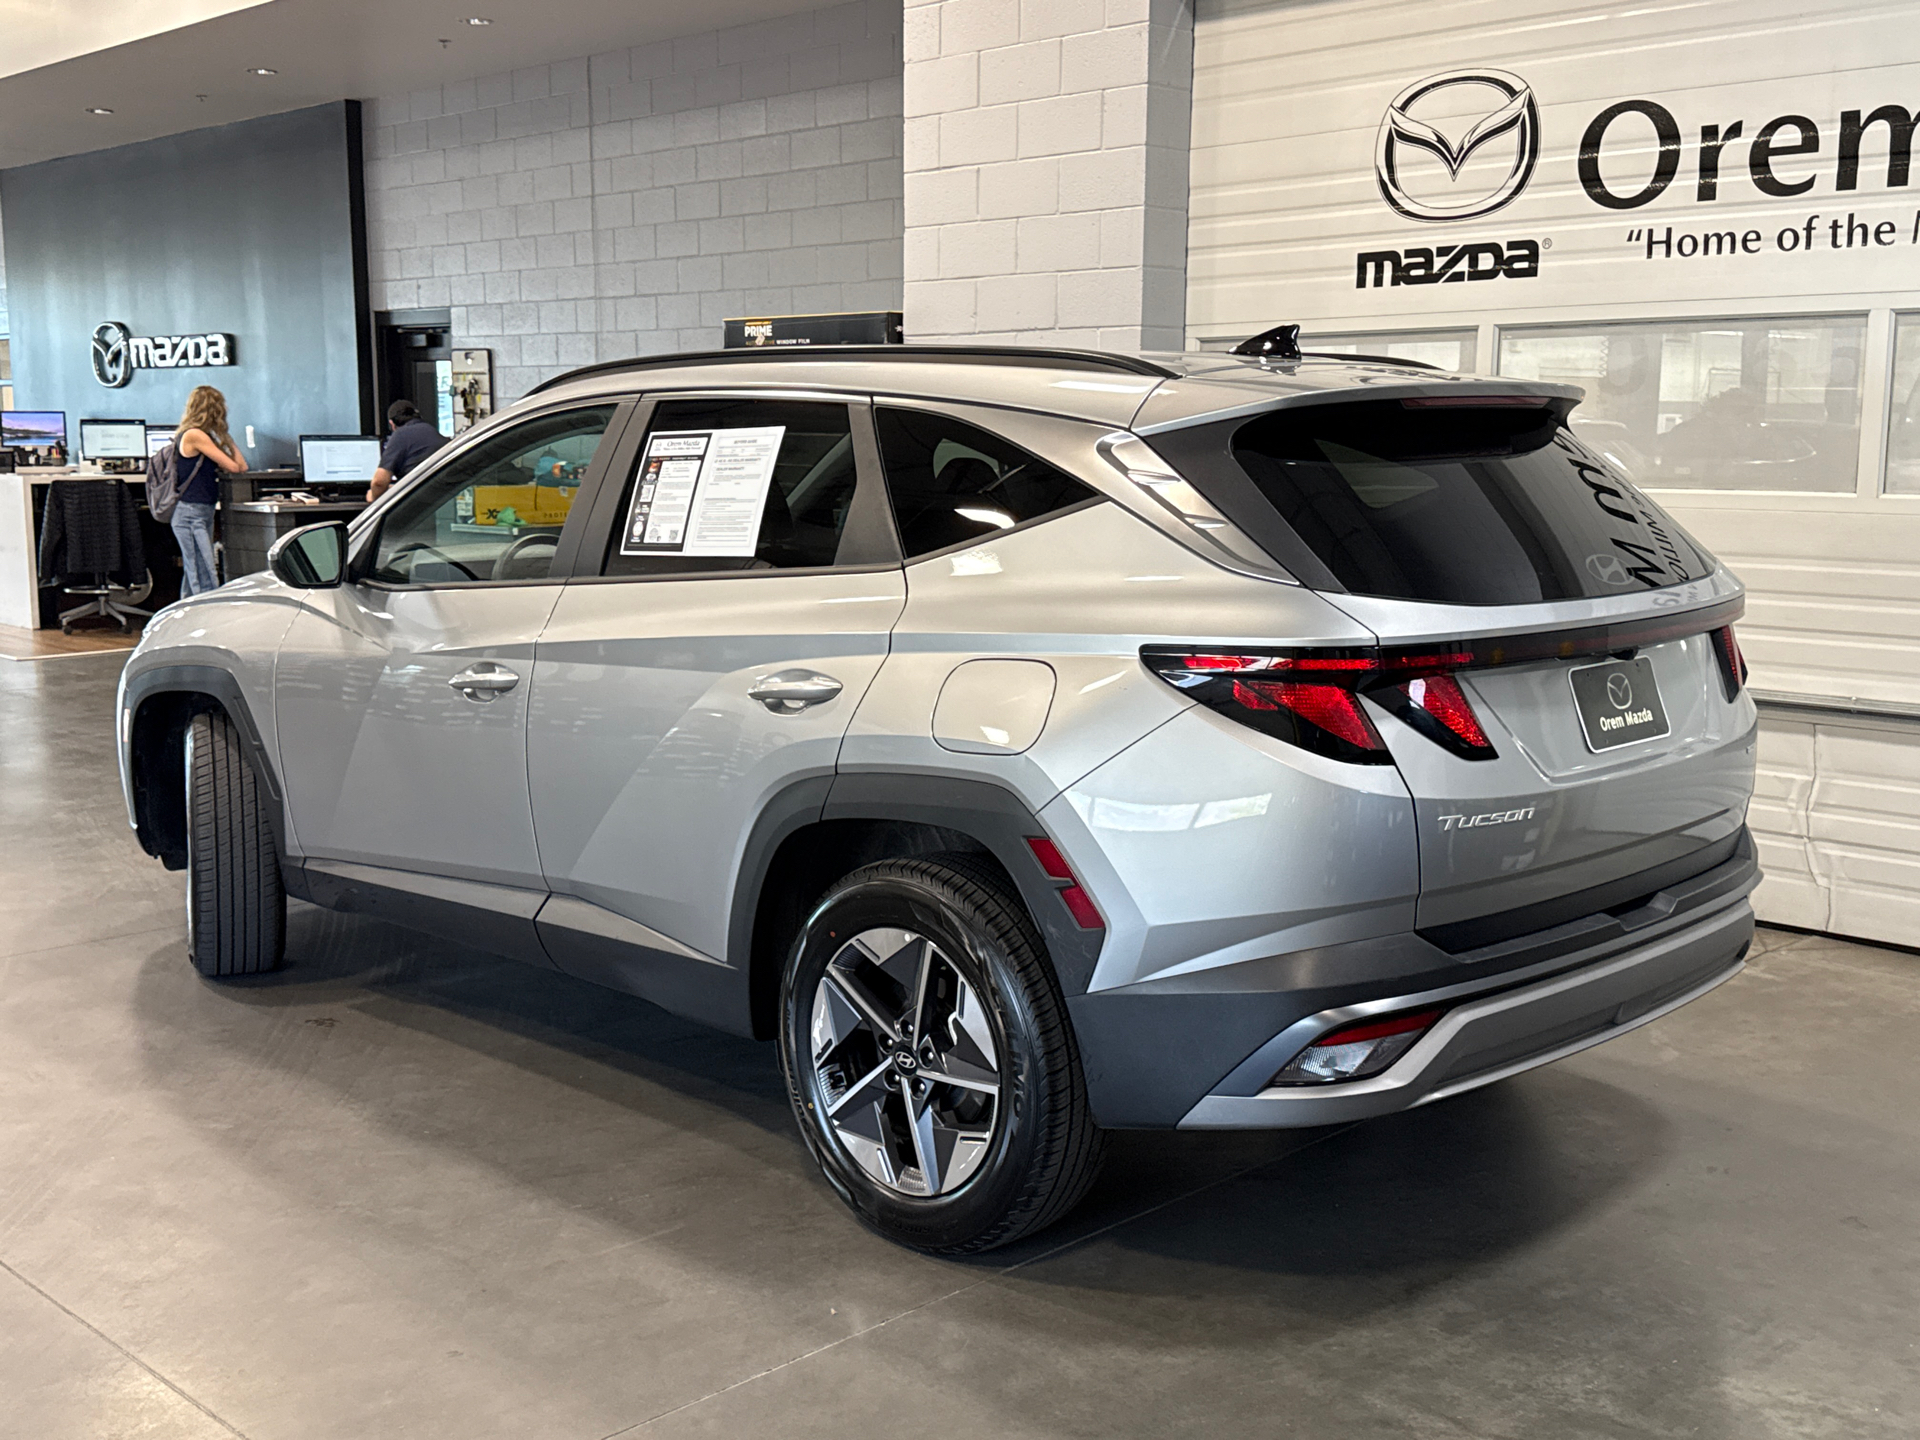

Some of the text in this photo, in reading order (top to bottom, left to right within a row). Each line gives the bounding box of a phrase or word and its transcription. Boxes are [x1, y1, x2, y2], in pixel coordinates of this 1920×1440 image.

[1577, 98, 1920, 210] Orem
[1777, 214, 1820, 251] of
[1828, 212, 1897, 249] the
[744, 325, 772, 337] PRIME
[1599, 707, 1654, 732] Orem Mazda
